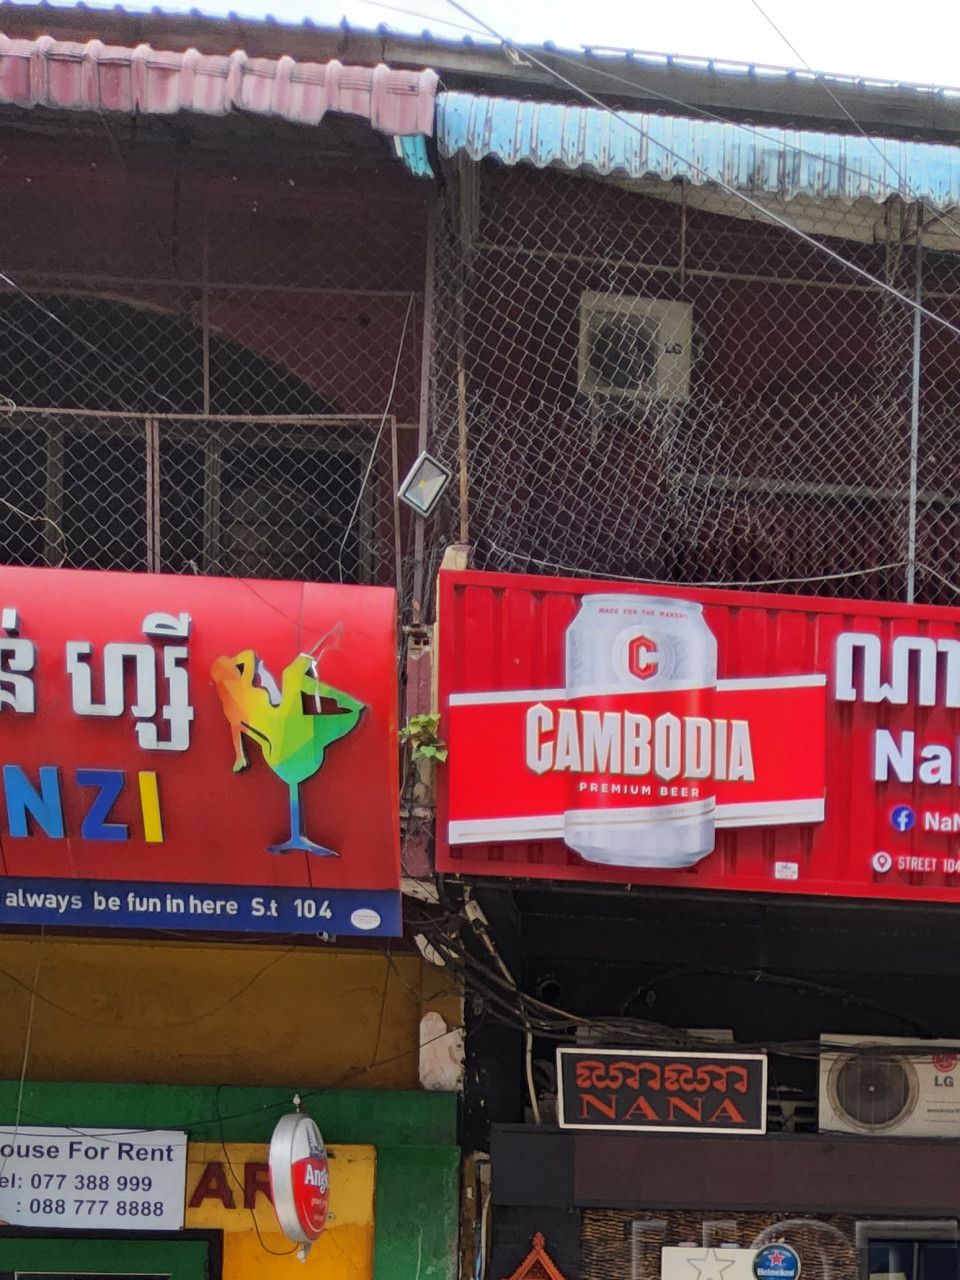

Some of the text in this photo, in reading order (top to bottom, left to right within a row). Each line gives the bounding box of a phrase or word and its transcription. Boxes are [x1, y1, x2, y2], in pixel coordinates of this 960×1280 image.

[525, 702, 756, 783] CAMBODIA
[579, 781, 700, 798] PREMIUM BEER
[2, 764, 164, 843] NZI
[898, 858, 936, 872] STREET
[943, 860, 960, 873] 104
[6, 888, 82, 914] always
[93, 890, 121, 912] be
[127, 891, 162, 913] fun
[166, 893, 187, 913] in
[189, 893, 238, 915] here
[294, 898, 333, 919] 104
[934, 1075, 954, 1088] LG
[578, 1093, 747, 1123] NANA
[0, 1141, 174, 1163] ouse For Rent
[31, 1173, 66, 1190] 077
[74, 1174, 109, 1191] 388
[117, 1175, 152, 1192] 999
[29, 1198, 65, 1214] 088
[73, 1199, 109, 1215] 777
[116, 1201, 164, 1217] 8888
